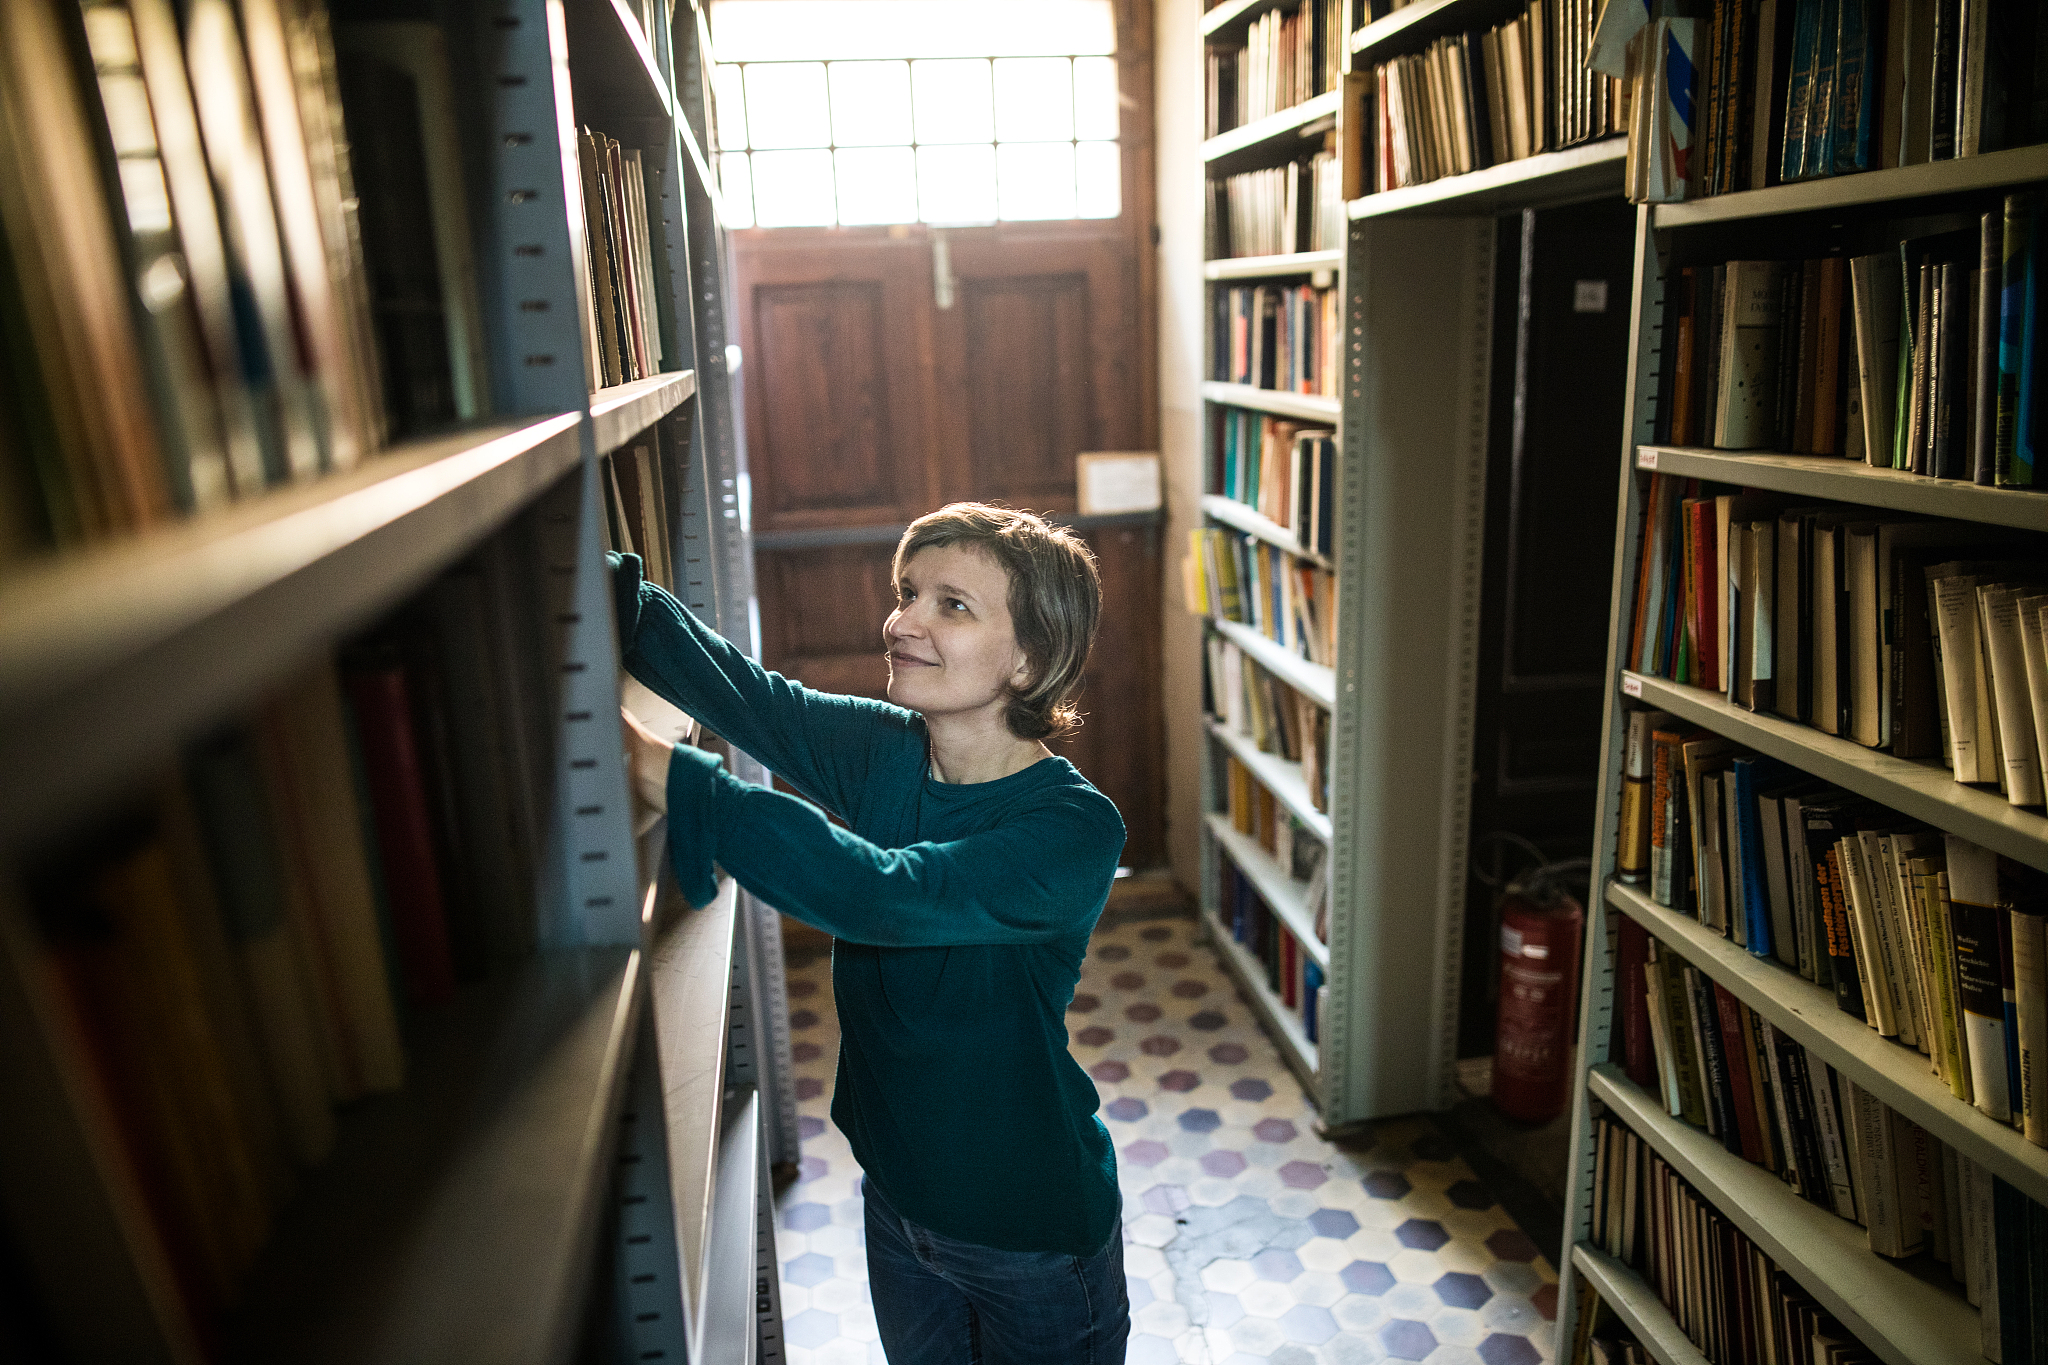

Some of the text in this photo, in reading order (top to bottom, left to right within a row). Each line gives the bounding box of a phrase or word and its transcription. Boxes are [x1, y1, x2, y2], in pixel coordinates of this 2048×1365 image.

[1789, 84, 1810, 142] fizika
[1862, 835, 1868, 844] 1
[1881, 843, 1888, 853] 2
[1815, 862, 1837, 957] Grundlagen der
[1877, 910, 1888, 941] Mechanik
[1884, 941, 1894, 976] Technische
